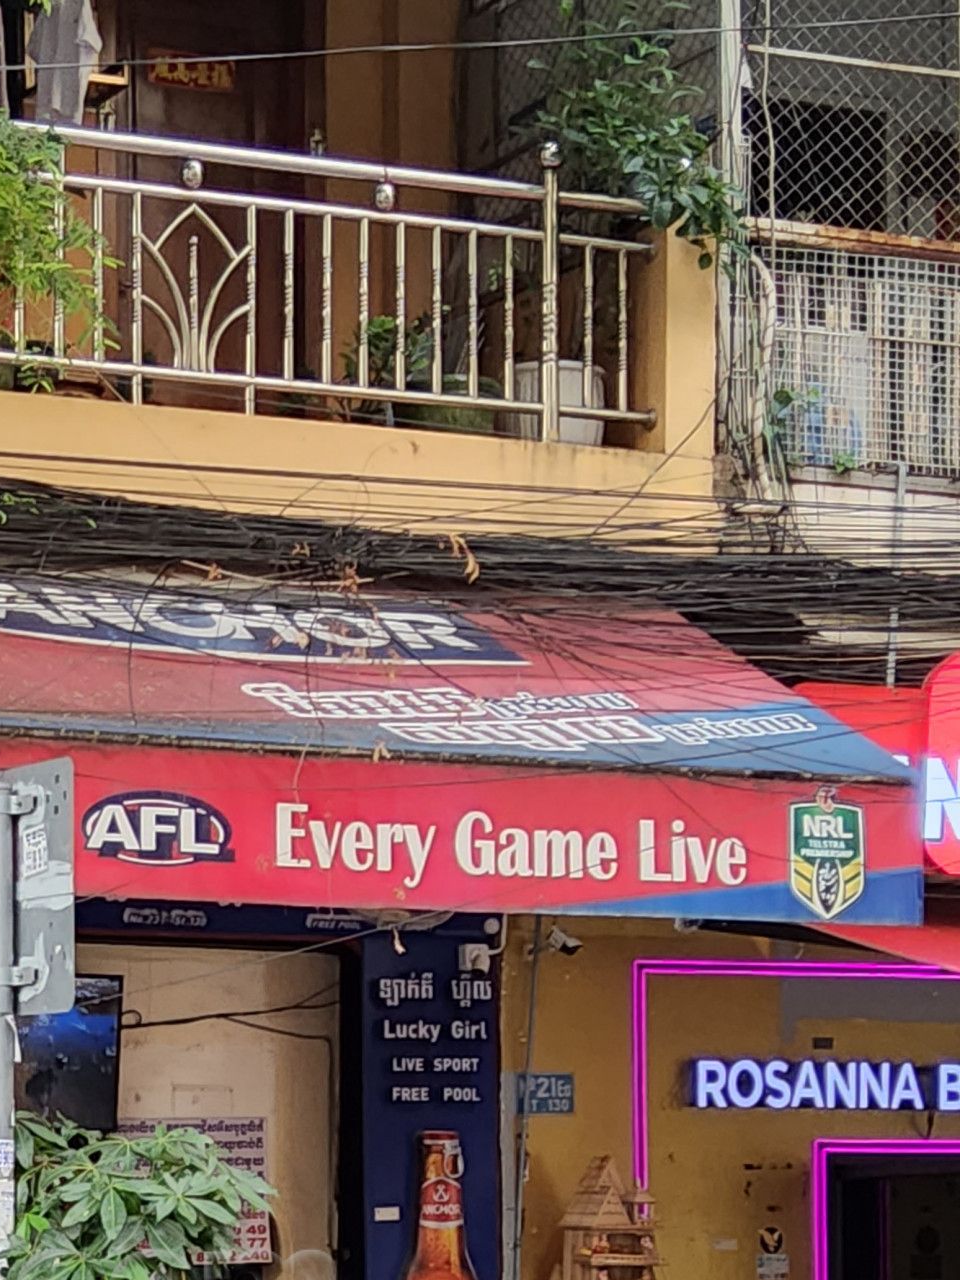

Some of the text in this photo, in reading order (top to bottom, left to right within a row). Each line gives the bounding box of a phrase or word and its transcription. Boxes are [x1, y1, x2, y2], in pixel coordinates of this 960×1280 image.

[86, 804, 221, 855] AFL
[803, 814, 854, 839] NRL
[275, 802, 748, 888] Every Game Live
[383, 1019, 488, 1043] Lucky Girl
[392, 1058, 480, 1072] LIVE SPORT
[392, 1087, 481, 1102] FREE POOL
[696, 1059, 925, 1110] ROSANNA
